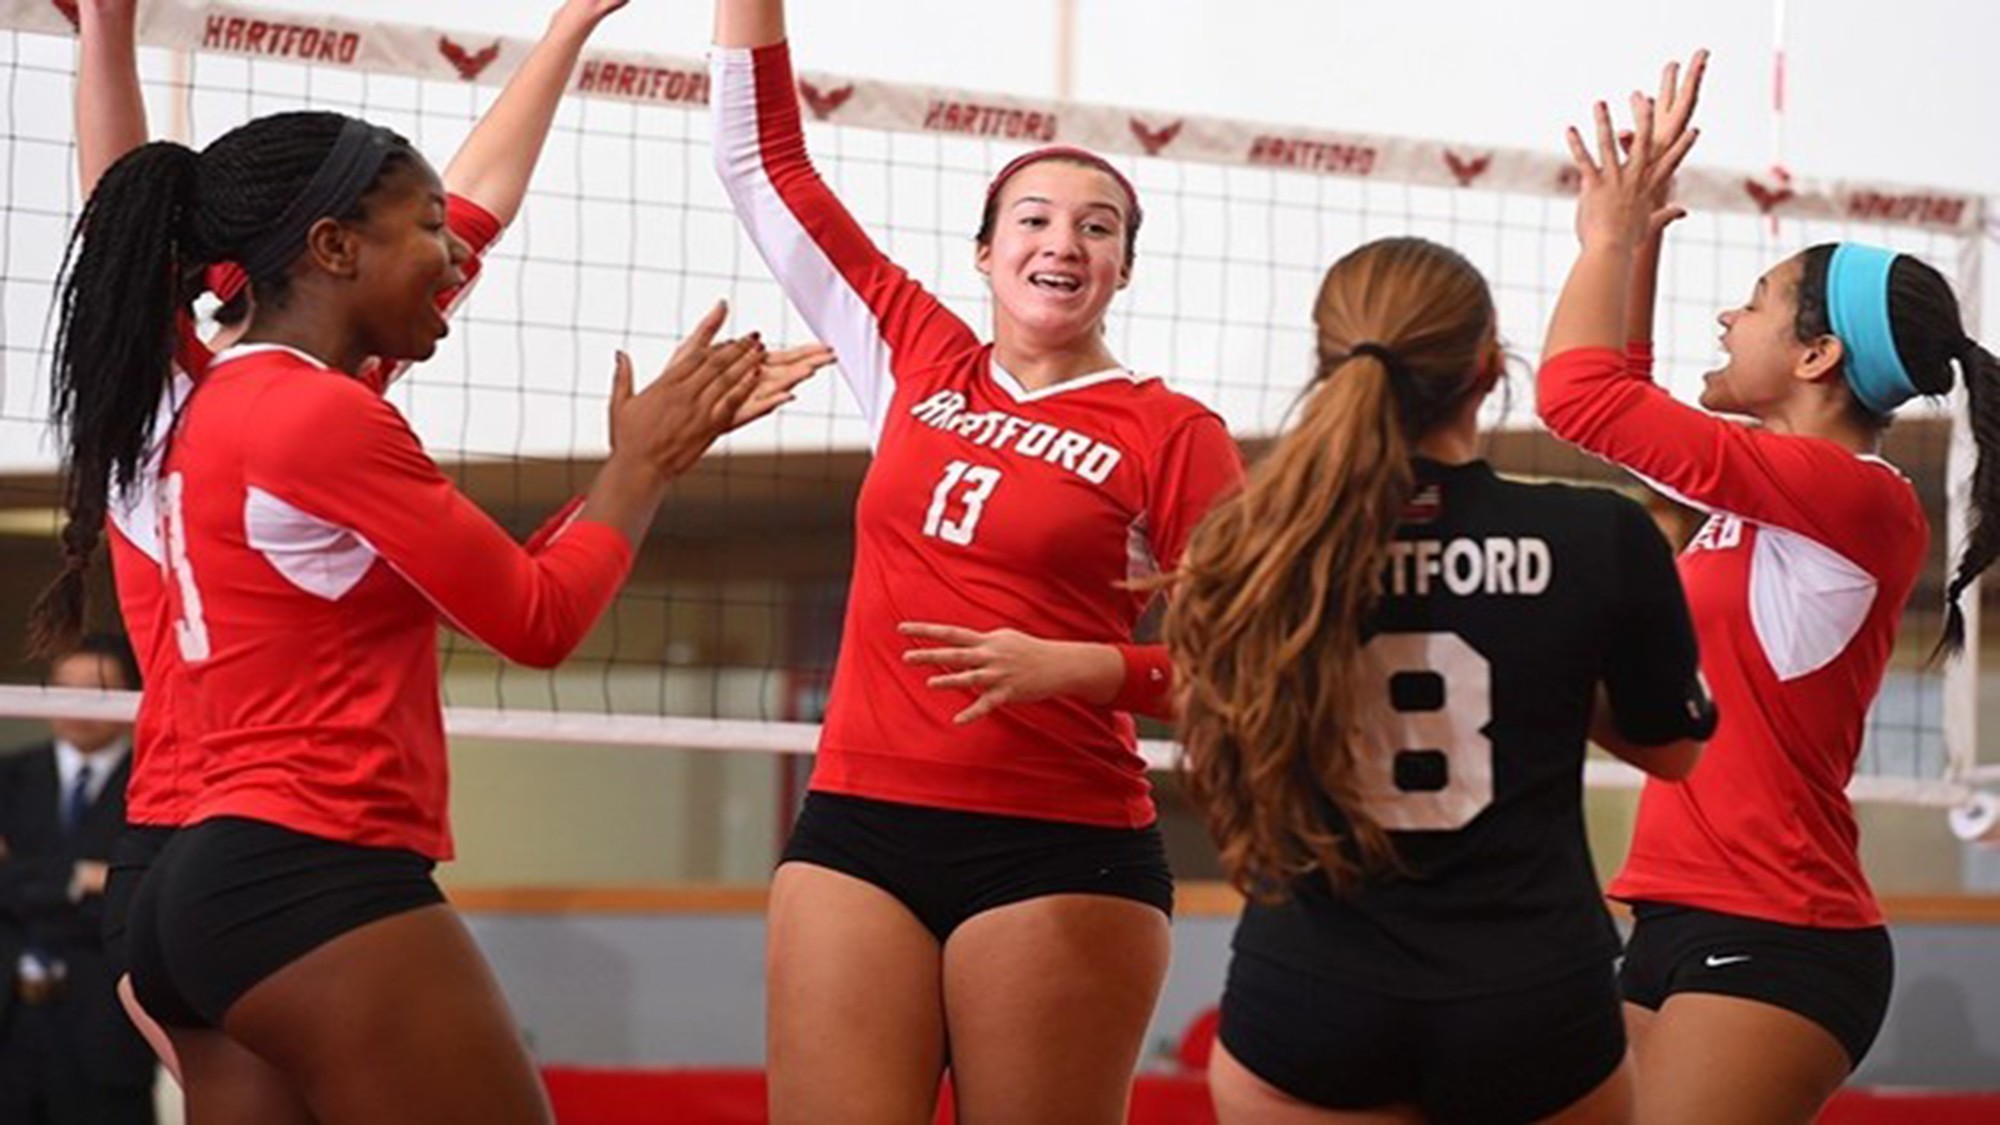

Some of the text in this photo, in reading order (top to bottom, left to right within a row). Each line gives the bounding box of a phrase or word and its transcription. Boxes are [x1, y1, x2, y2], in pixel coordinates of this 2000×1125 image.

[202, 14, 360, 64] HARTFORD
[910, 389, 1121, 484] HARTFORD
[922, 460, 1002, 546] 13
[1352, 631, 1495, 830] 8
